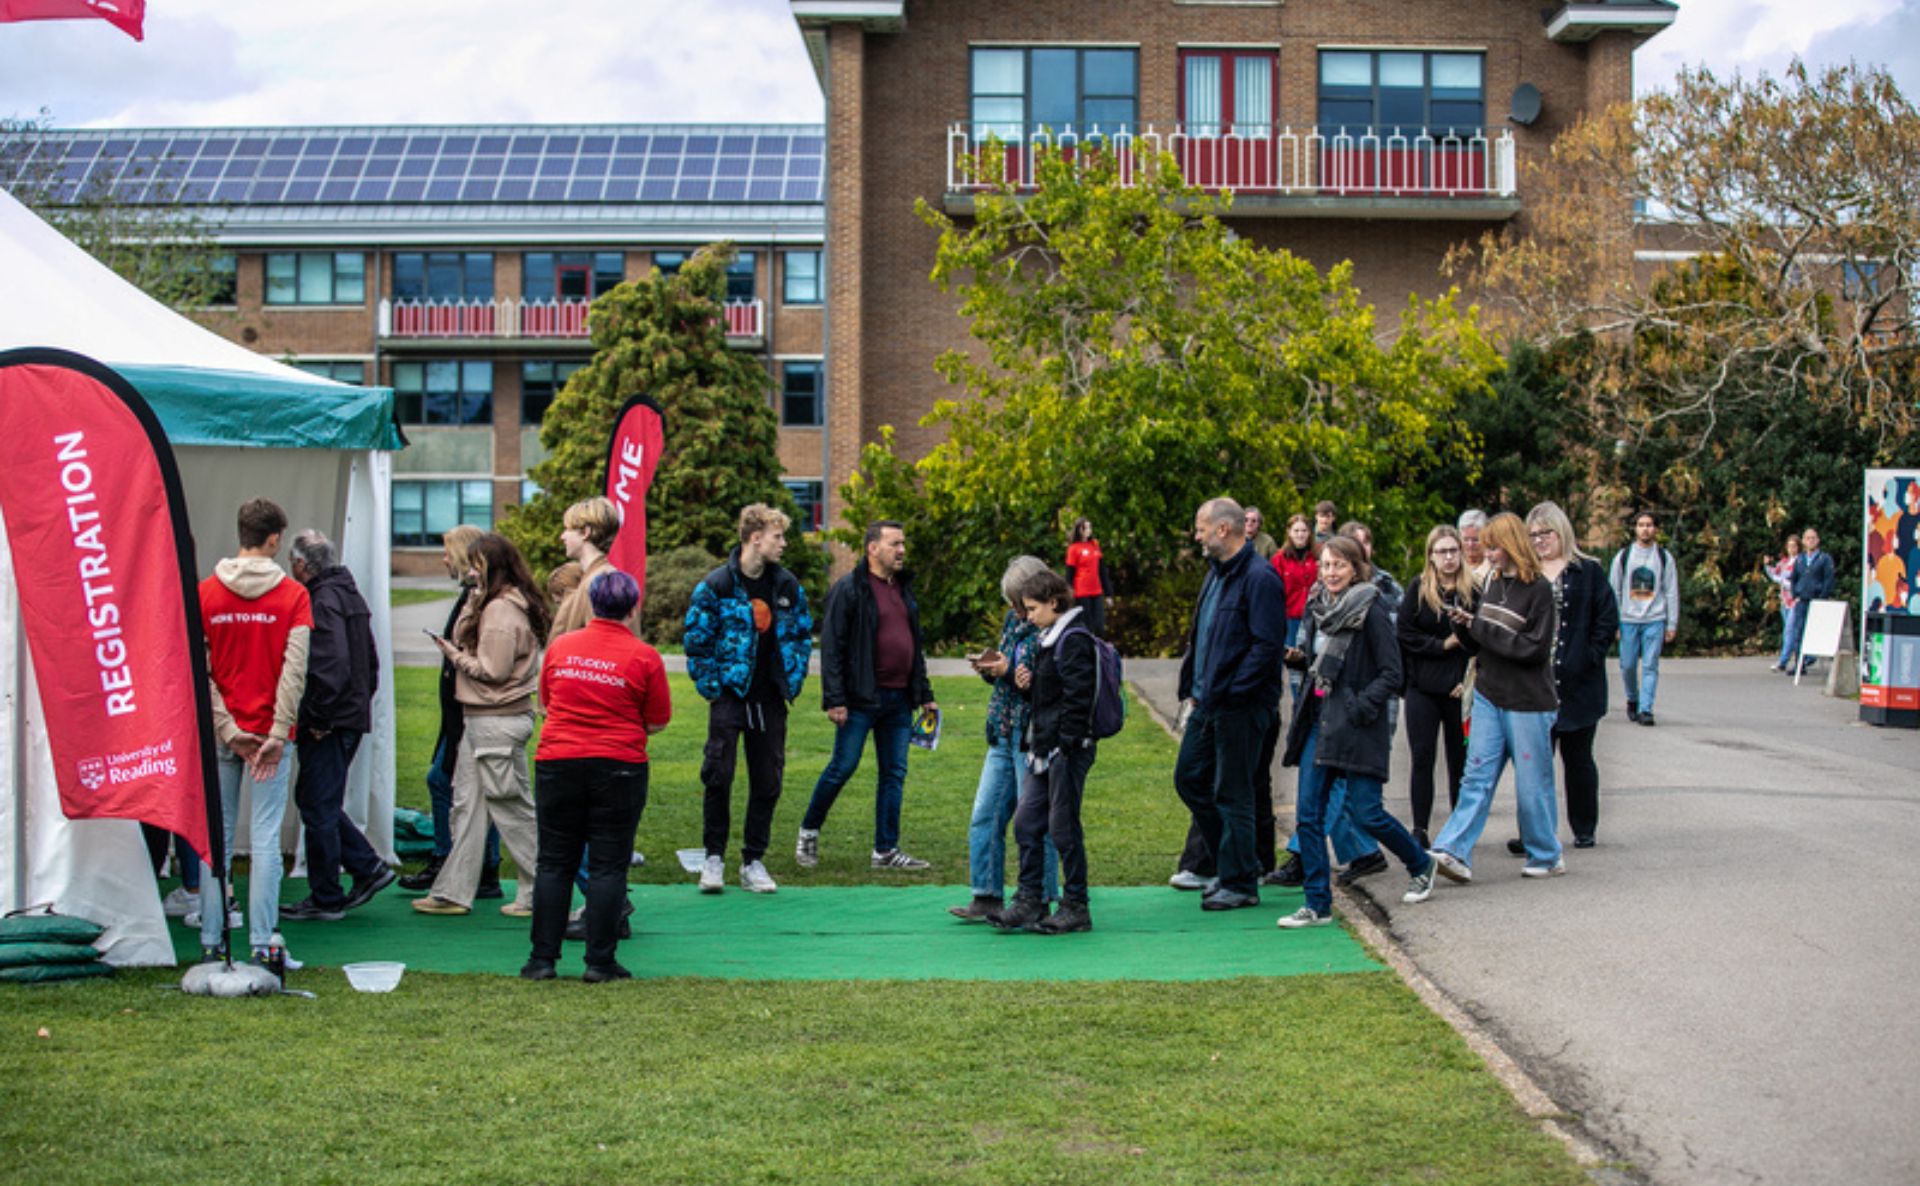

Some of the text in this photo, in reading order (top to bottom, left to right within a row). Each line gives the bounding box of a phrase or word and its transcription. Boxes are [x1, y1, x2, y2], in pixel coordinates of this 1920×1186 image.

[54, 431, 137, 717] REGISTRATION
[235, 613, 250, 623] TO
[251, 613, 277, 624] HELP
[566, 655, 617, 671] STUDENT
[554, 668, 625, 688] AMBASSADOR
[106, 739, 173, 765] University of
[109, 757, 177, 784] Reading
